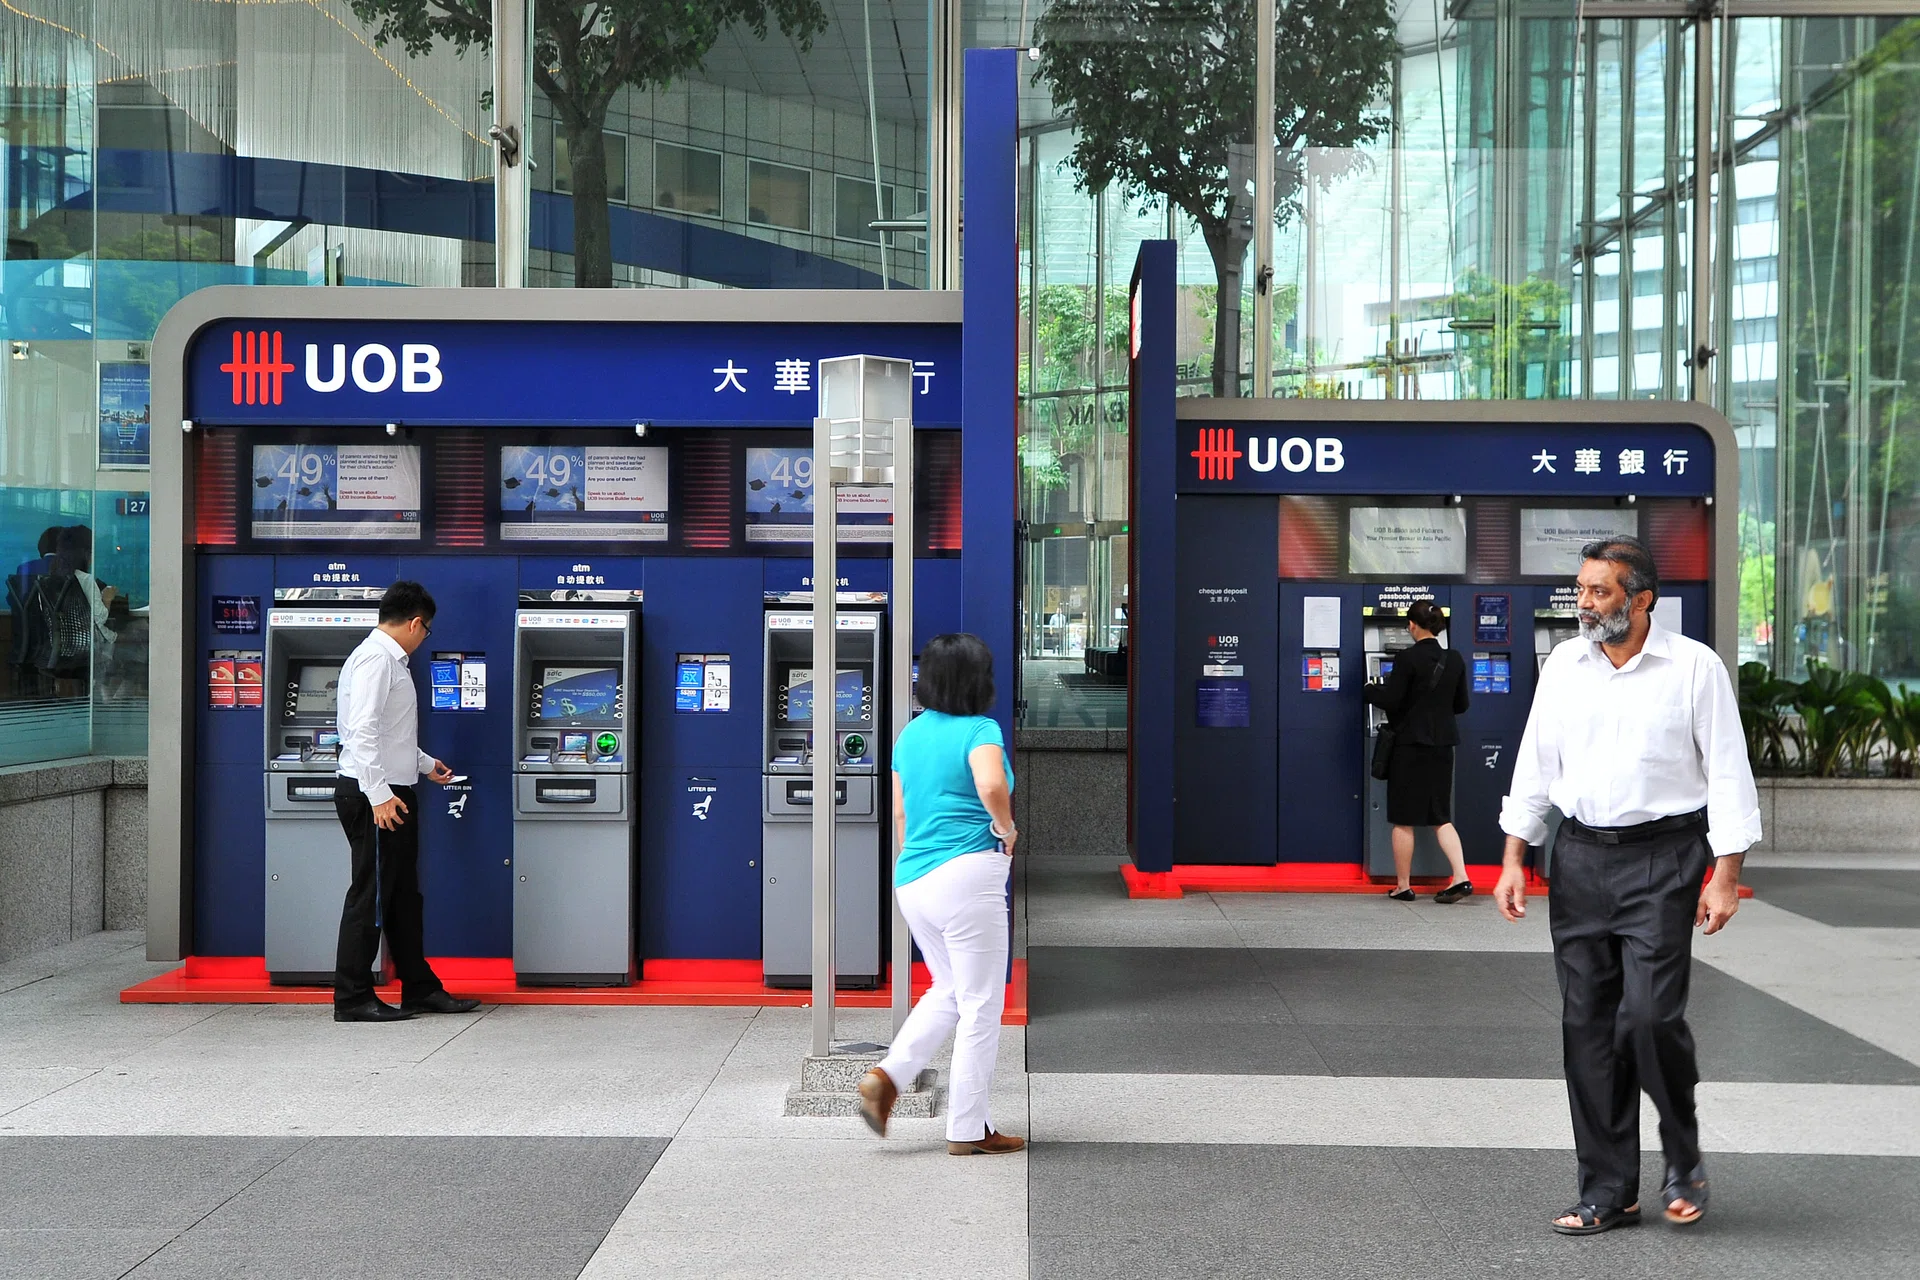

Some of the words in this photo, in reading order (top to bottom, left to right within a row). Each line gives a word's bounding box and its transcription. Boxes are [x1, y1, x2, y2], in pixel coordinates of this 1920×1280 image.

[305, 343, 443, 392] UOB
[713, 359, 936, 394] 大華行
[1249, 437, 1345, 472] UOB
[1531, 449, 1689, 475] 大華銀行
[770, 456, 813, 488] 49
[131, 502, 146, 512] 27
[572, 564, 590, 572] atm
[313, 573, 360, 582] 自动提款机
[557, 575, 604, 584] 自动提款机
[683, 673, 696, 682] 6X
